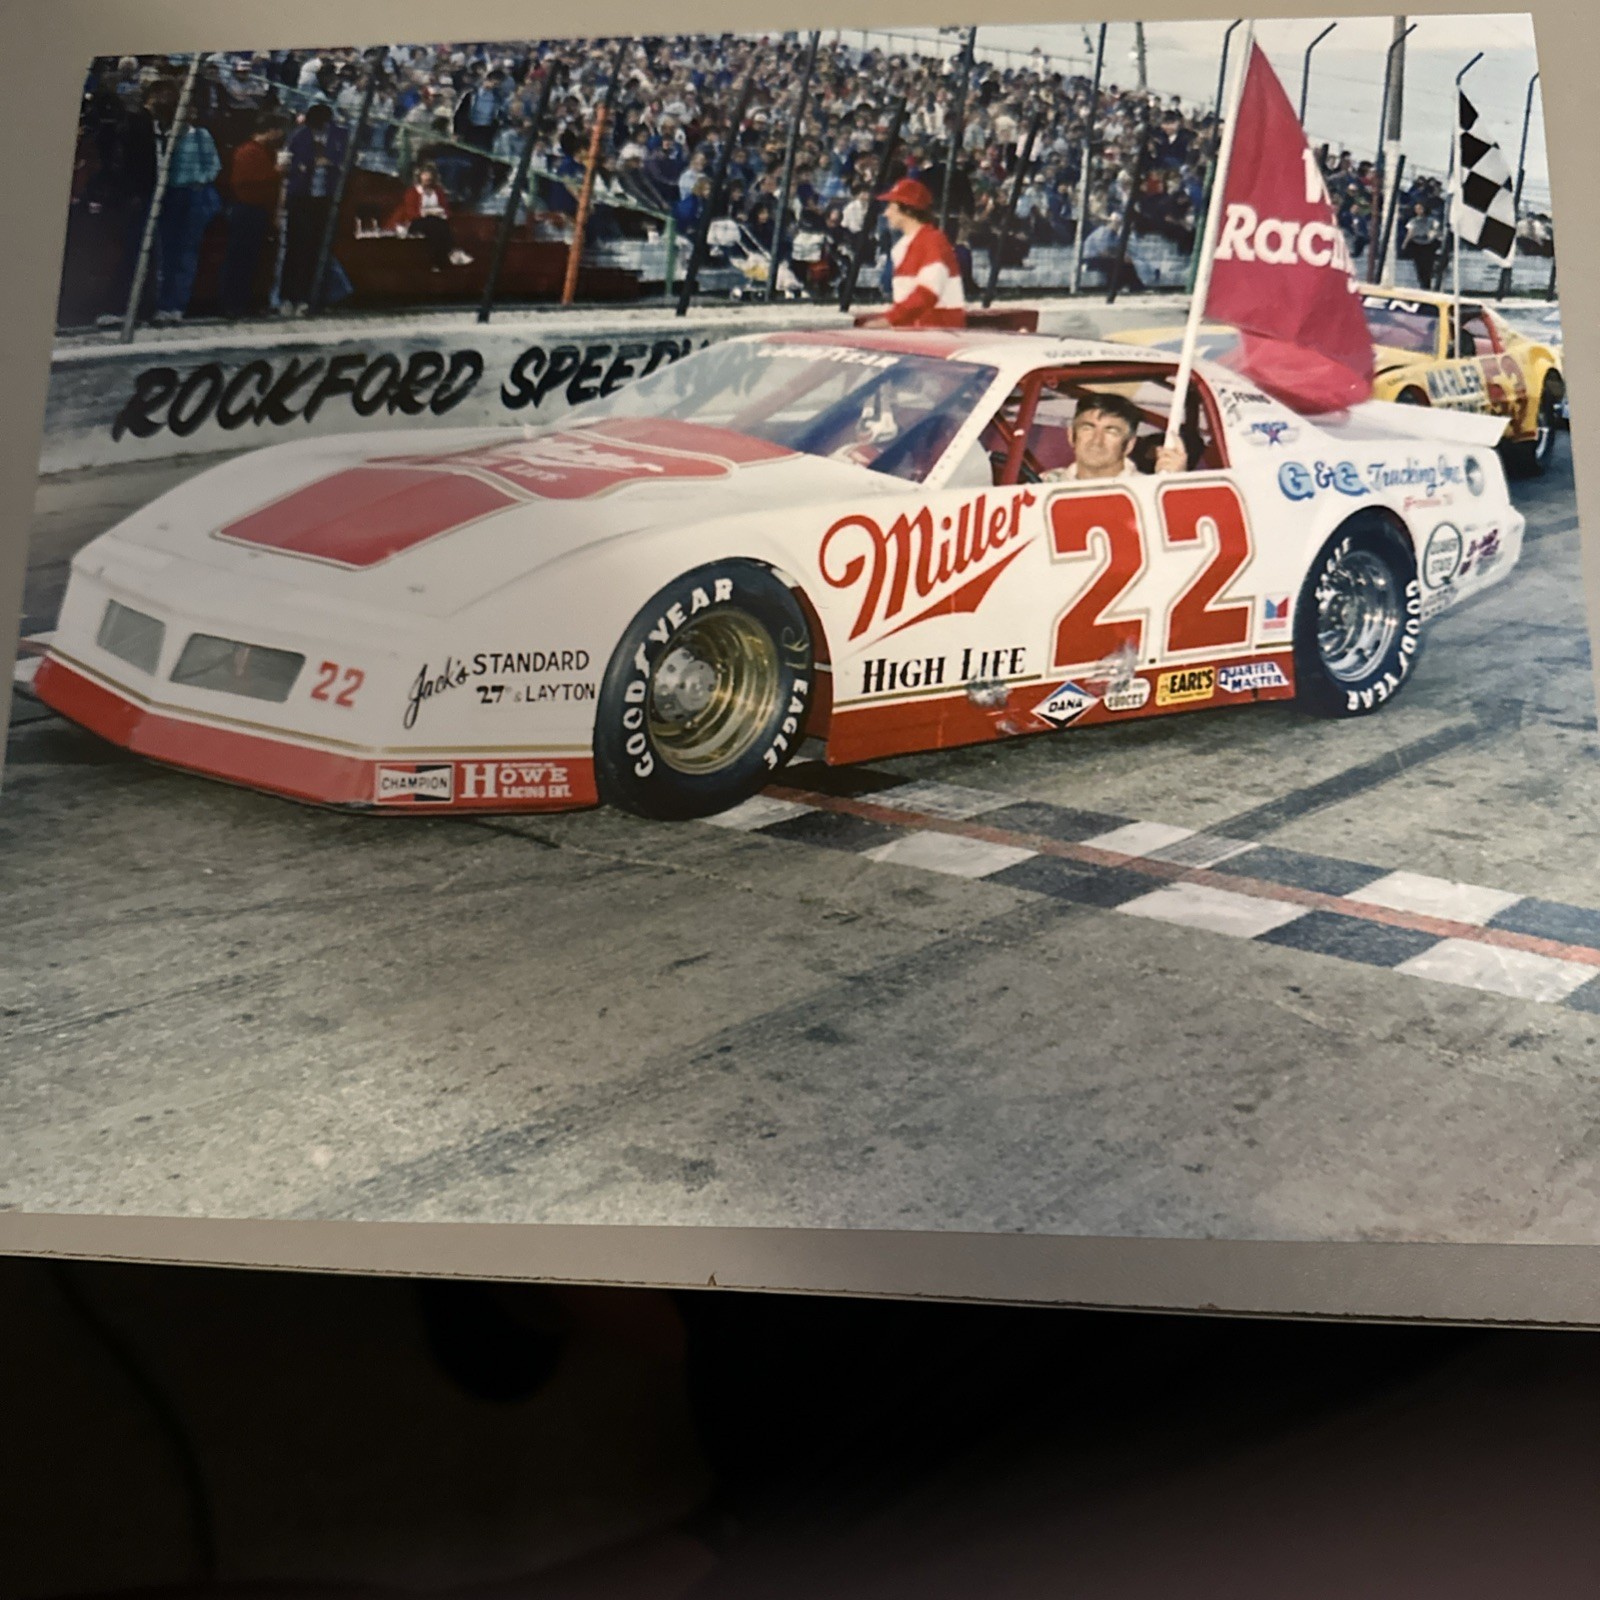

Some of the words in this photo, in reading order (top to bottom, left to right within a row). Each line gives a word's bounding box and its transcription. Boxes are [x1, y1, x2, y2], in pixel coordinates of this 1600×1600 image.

[1362, 296, 1421, 314] EN
[111, 350, 485, 442] ROCKFORD
[501, 337, 765, 411] SPEED
[819, 489, 1037, 642] Miller
[1048, 482, 1252, 669] 22
[1346, 579, 1421, 711] GOODYEAR
[310, 660, 365, 708] 22
[403, 656, 470, 730] Jack's
[472, 650, 590, 676] STANDARD
[526, 682, 596, 703] LAYTON
[622, 578, 734, 778] GOODYEAR
[861, 657, 946, 694] HIGH
[960, 646, 1027, 682] LIFE
[1169, 668, 1214, 693] EARL'S
[1219, 662, 1276, 685] QUARTER
[1231, 674, 1283, 691] MASTER
[763, 678, 809, 770] EAGLE
[1048, 698, 1084, 713] DANA
[381, 776, 448, 790] CHAMPION
[460, 763, 568, 798] HOWE
